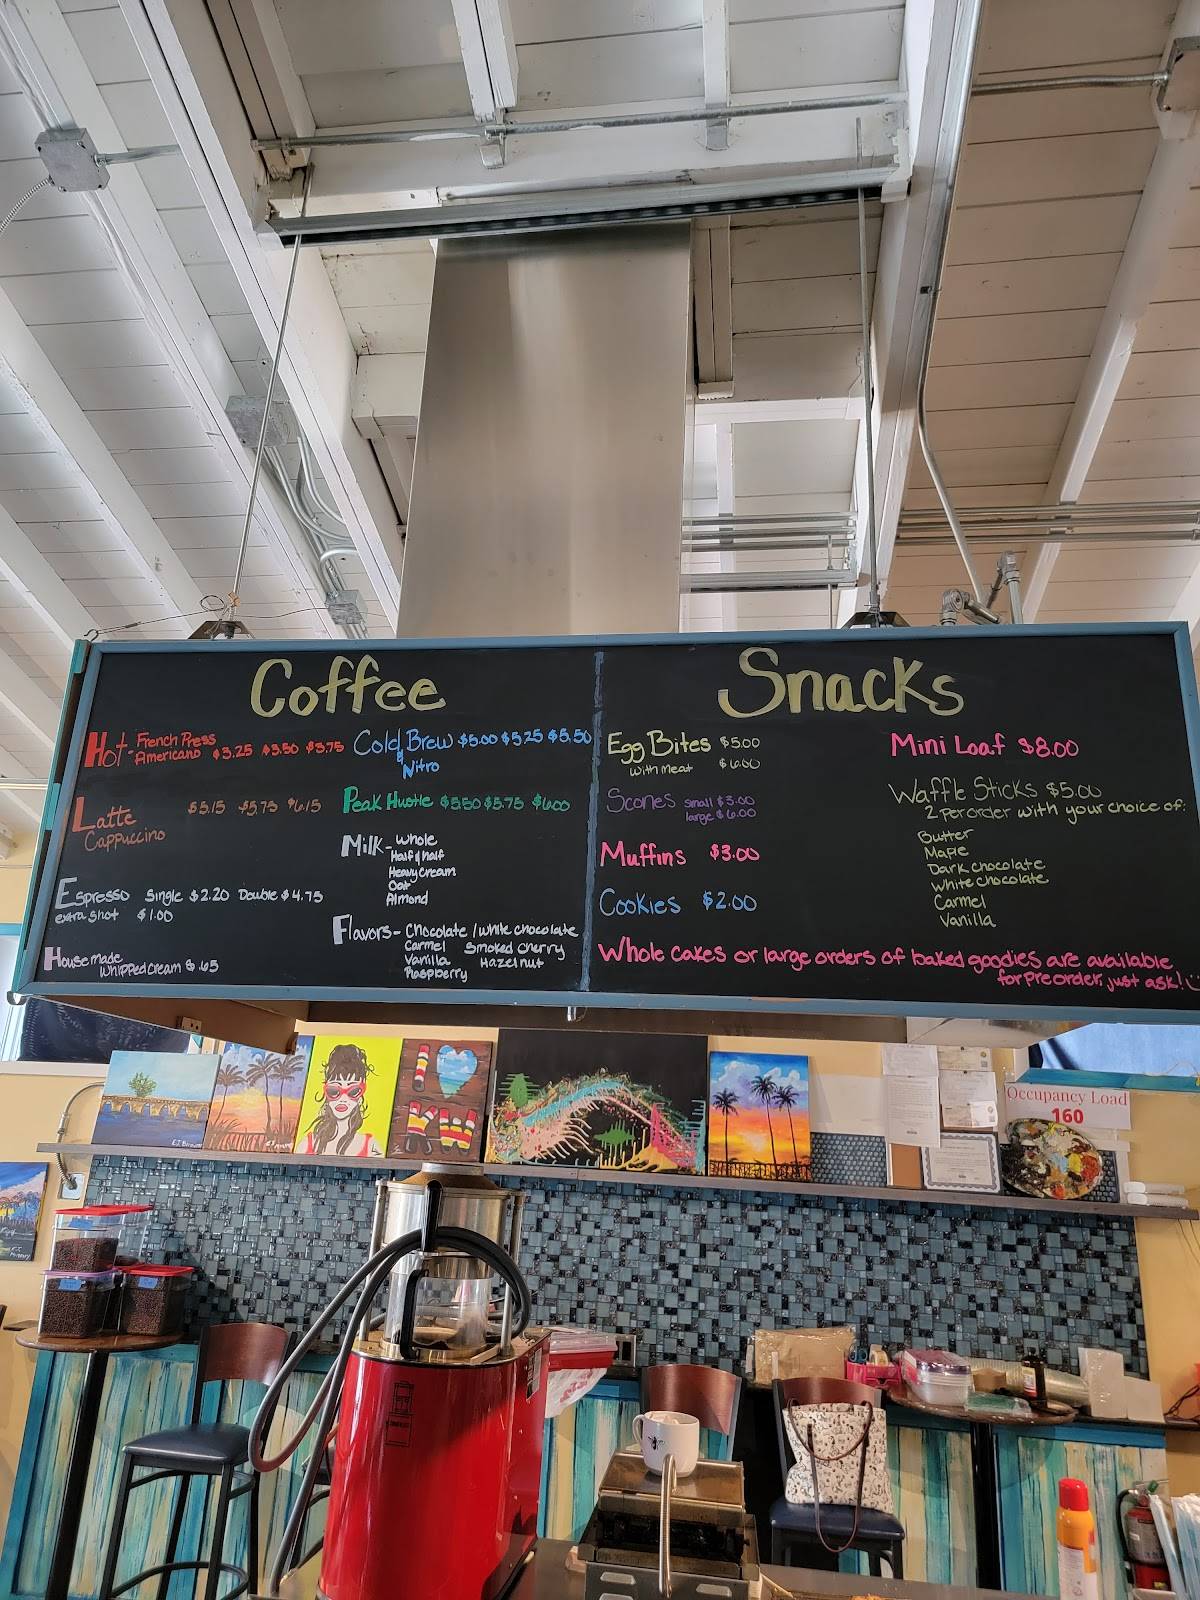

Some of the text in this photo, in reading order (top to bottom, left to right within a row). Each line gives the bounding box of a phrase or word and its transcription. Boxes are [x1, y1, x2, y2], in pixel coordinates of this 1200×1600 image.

[250, 654, 446, 718] Coffee
[718, 646, 964, 719] Snacks
[136, 731, 217, 750] French Press
[353, 727, 592, 757] Cold Brew $5.00 $5.25 $5.50
[607, 729, 760, 765] Egg Bites $5.00
[890, 732, 1079, 758] Mini Loaf $8.00
[135, 749, 201, 766] Americano
[212, 743, 253, 761] $3.25
[306, 740, 345, 754] $3.75
[402, 758, 440, 780] Nitro
[629, 761, 658, 777] with
[719, 758, 761, 771] $6.00
[888, 775, 1102, 804] Waffle Sticks $5.00
[343, 786, 382, 813] Peak
[386, 791, 434, 809] Hustle
[607, 787, 676, 813] Scones
[683, 798, 713, 808] small
[72, 796, 137, 832] Latte
[685, 809, 757, 826] large $6.00
[925, 806, 938, 820] 2
[939, 808, 966, 822] per
[966, 806, 1011, 820] order
[1017, 801, 1059, 819] with
[1065, 802, 1104, 824] your
[1107, 800, 1161, 812] choice
[84, 829, 166, 852] Cappuccino
[917, 828, 974, 844] Butter
[391, 850, 414, 863] Half
[422, 848, 445, 862] half
[600, 841, 760, 868] Muffins $3.00
[924, 846, 969, 860] Maple
[389, 866, 418, 884] Heavy
[927, 858, 1046, 876] Dark chocolate
[388, 880, 412, 892] Oat
[976, 872, 1049, 888] chocolate
[55, 877, 130, 910] Espresso
[145, 889, 184, 906] Single
[238, 889, 279, 901] Double
[386, 890, 429, 907] Almond
[599, 888, 758, 916] Cookies $2.00
[934, 894, 987, 911] Carmel
[55, 911, 88, 924] extra
[88, 910, 120, 924] shot
[940, 912, 997, 928] Vanilla
[404, 940, 446, 952] Carmel
[464, 942, 514, 955] Smoked
[598, 936, 1174, 974] Whole cakes or large orders of baked goodies are available
[404, 954, 450, 967] Vanilla
[404, 967, 468, 983] Raspberry
[997, 969, 1023, 987] for
[1106, 973, 1140, 993] just
[1144, 970, 1184, 991] ask!
[1005, 1087, 1129, 1107] Occupancy Load
[1051, 1108, 1084, 1125] 160
